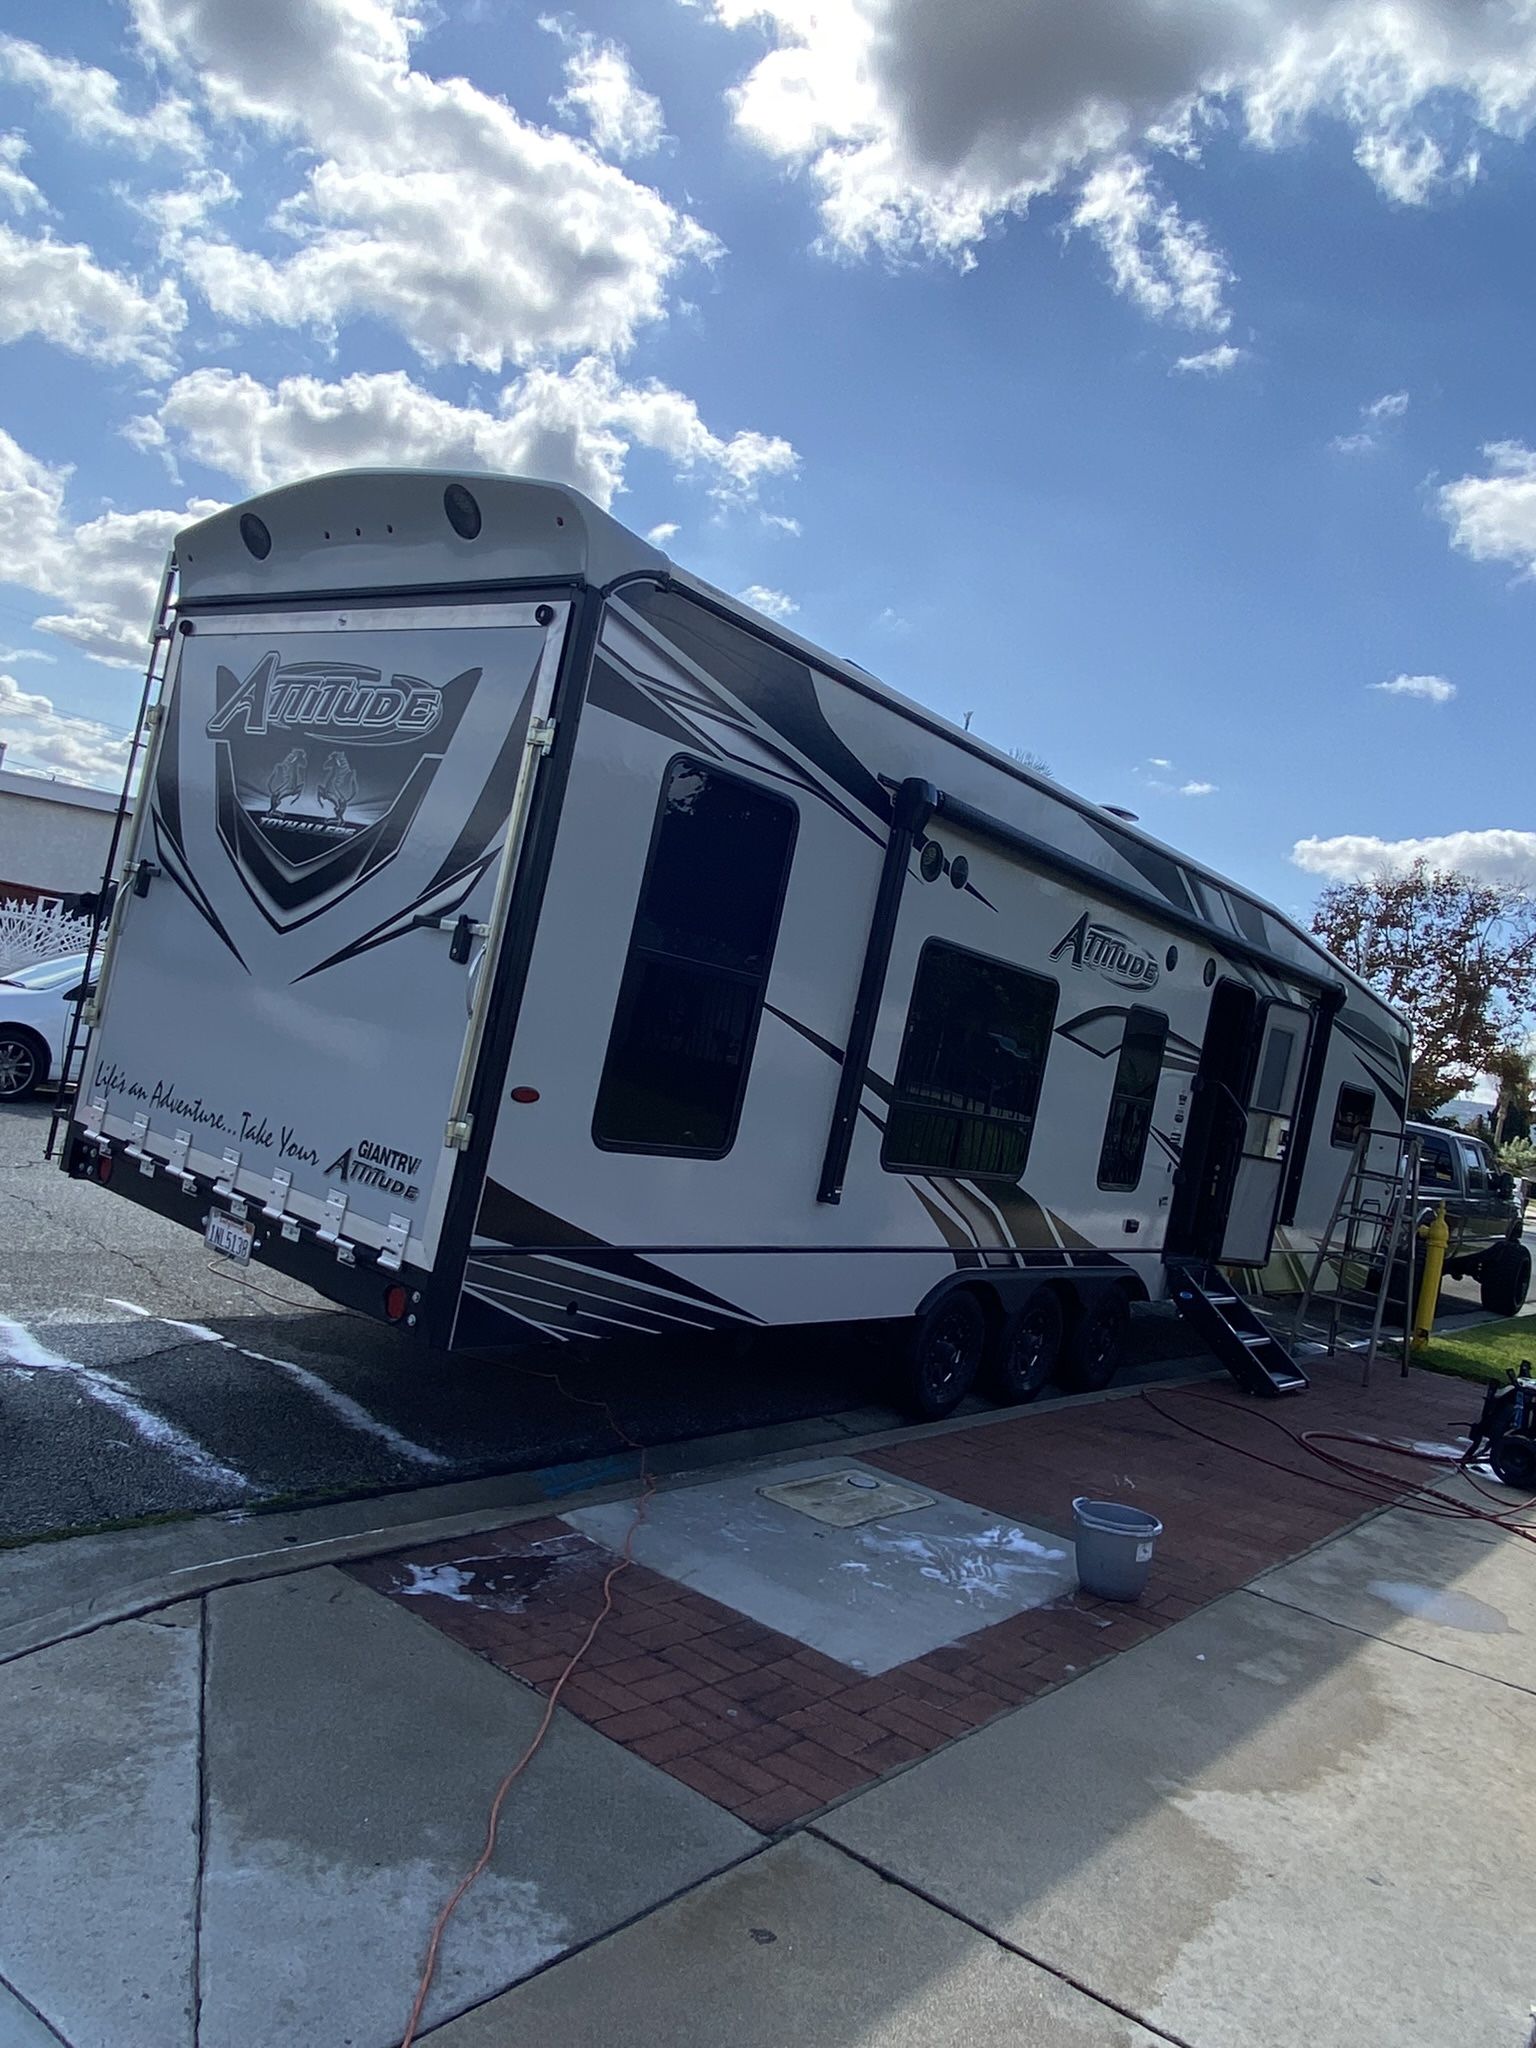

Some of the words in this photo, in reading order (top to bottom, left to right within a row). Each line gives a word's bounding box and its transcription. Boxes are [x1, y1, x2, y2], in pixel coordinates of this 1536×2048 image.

[95, 1060, 126, 1098] Life's
[128, 1082, 148, 1099] an
[239, 1111, 274, 1148] Take
[278, 1126, 319, 1166] Your
